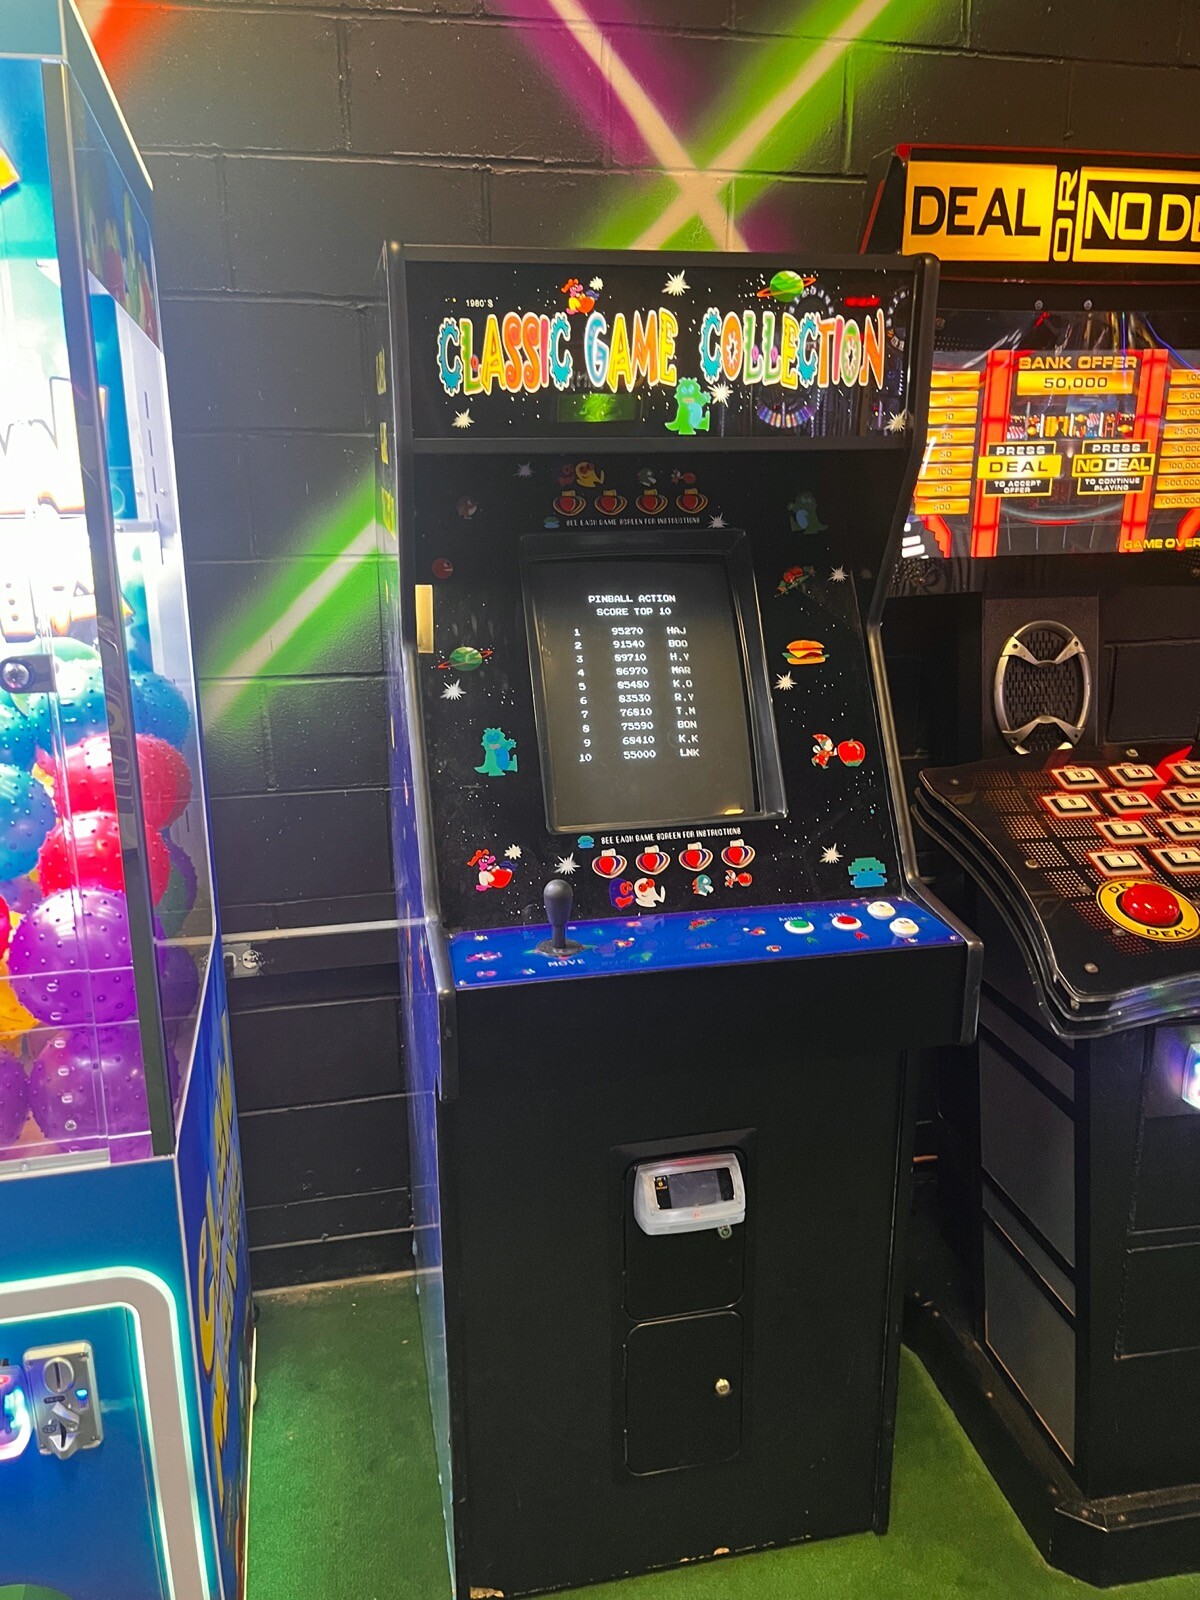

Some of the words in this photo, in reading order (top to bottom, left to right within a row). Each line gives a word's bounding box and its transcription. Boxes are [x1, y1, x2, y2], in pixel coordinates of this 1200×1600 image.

[911, 186, 1041, 236] DEAL
[1053, 169, 1078, 262] OR
[1084, 190, 1152, 240] NO
[466, 299, 494, 308] 1980'S
[437, 311, 573, 396] CLASSIC
[584, 307, 679, 393] GAME
[700, 306, 885, 391] COLLECTION
[1018, 356, 1072, 369] BANK
[1077, 356, 1137, 369] OFFER
[1044, 377, 1108, 390] 50,000
[945, 412, 954, 420] 10
[996, 445, 1046, 456] PRESS
[1091, 443, 1141, 453] PRESS
[940, 451, 952, 459] 50
[989, 460, 1048, 473] DEAL
[1077, 459, 1103, 473] NO
[1104, 458, 1150, 472] DEAL
[938, 468, 953, 476] 100
[1008, 479, 1042, 487] ACCEPT
[1084, 478, 1096, 486] TO
[1098, 477, 1140, 486] CONTINUE
[1003, 486, 1031, 494] OFFER
[1094, 484, 1129, 492] PLAYING
[933, 503, 951, 511] 500
[1123, 538, 1163, 549] GAME
[1164, 537, 1200, 548] OVER
[588, 595, 633, 603] PINBALL
[638, 594, 676, 603] ACTION
[596, 608, 629, 616] SCORE
[634, 608, 653, 616] TOP
[659, 607, 672, 615] 10
[574, 628, 580, 636] 1
[575, 642, 582, 650] 2
[576, 655, 584, 663] 3
[577, 669, 585, 677] 4
[671, 666, 691, 674] MAR
[579, 683, 586, 691] 5
[581, 710, 588, 718] 7
[582, 724, 590, 733] 8
[677, 720, 697, 728] BON
[584, 739, 591, 747] 9
[678, 734, 699, 743] K.K
[579, 753, 592, 762] 10
[680, 748, 700, 757] LNK
[601, 836, 614, 845] SEE
[635, 833, 655, 842] GAME
[682, 830, 695, 839] FOR
[1117, 855, 1125, 864] 1
[1146, 926, 1193, 937] DEAL
[548, 958, 586, 968] MOVE
